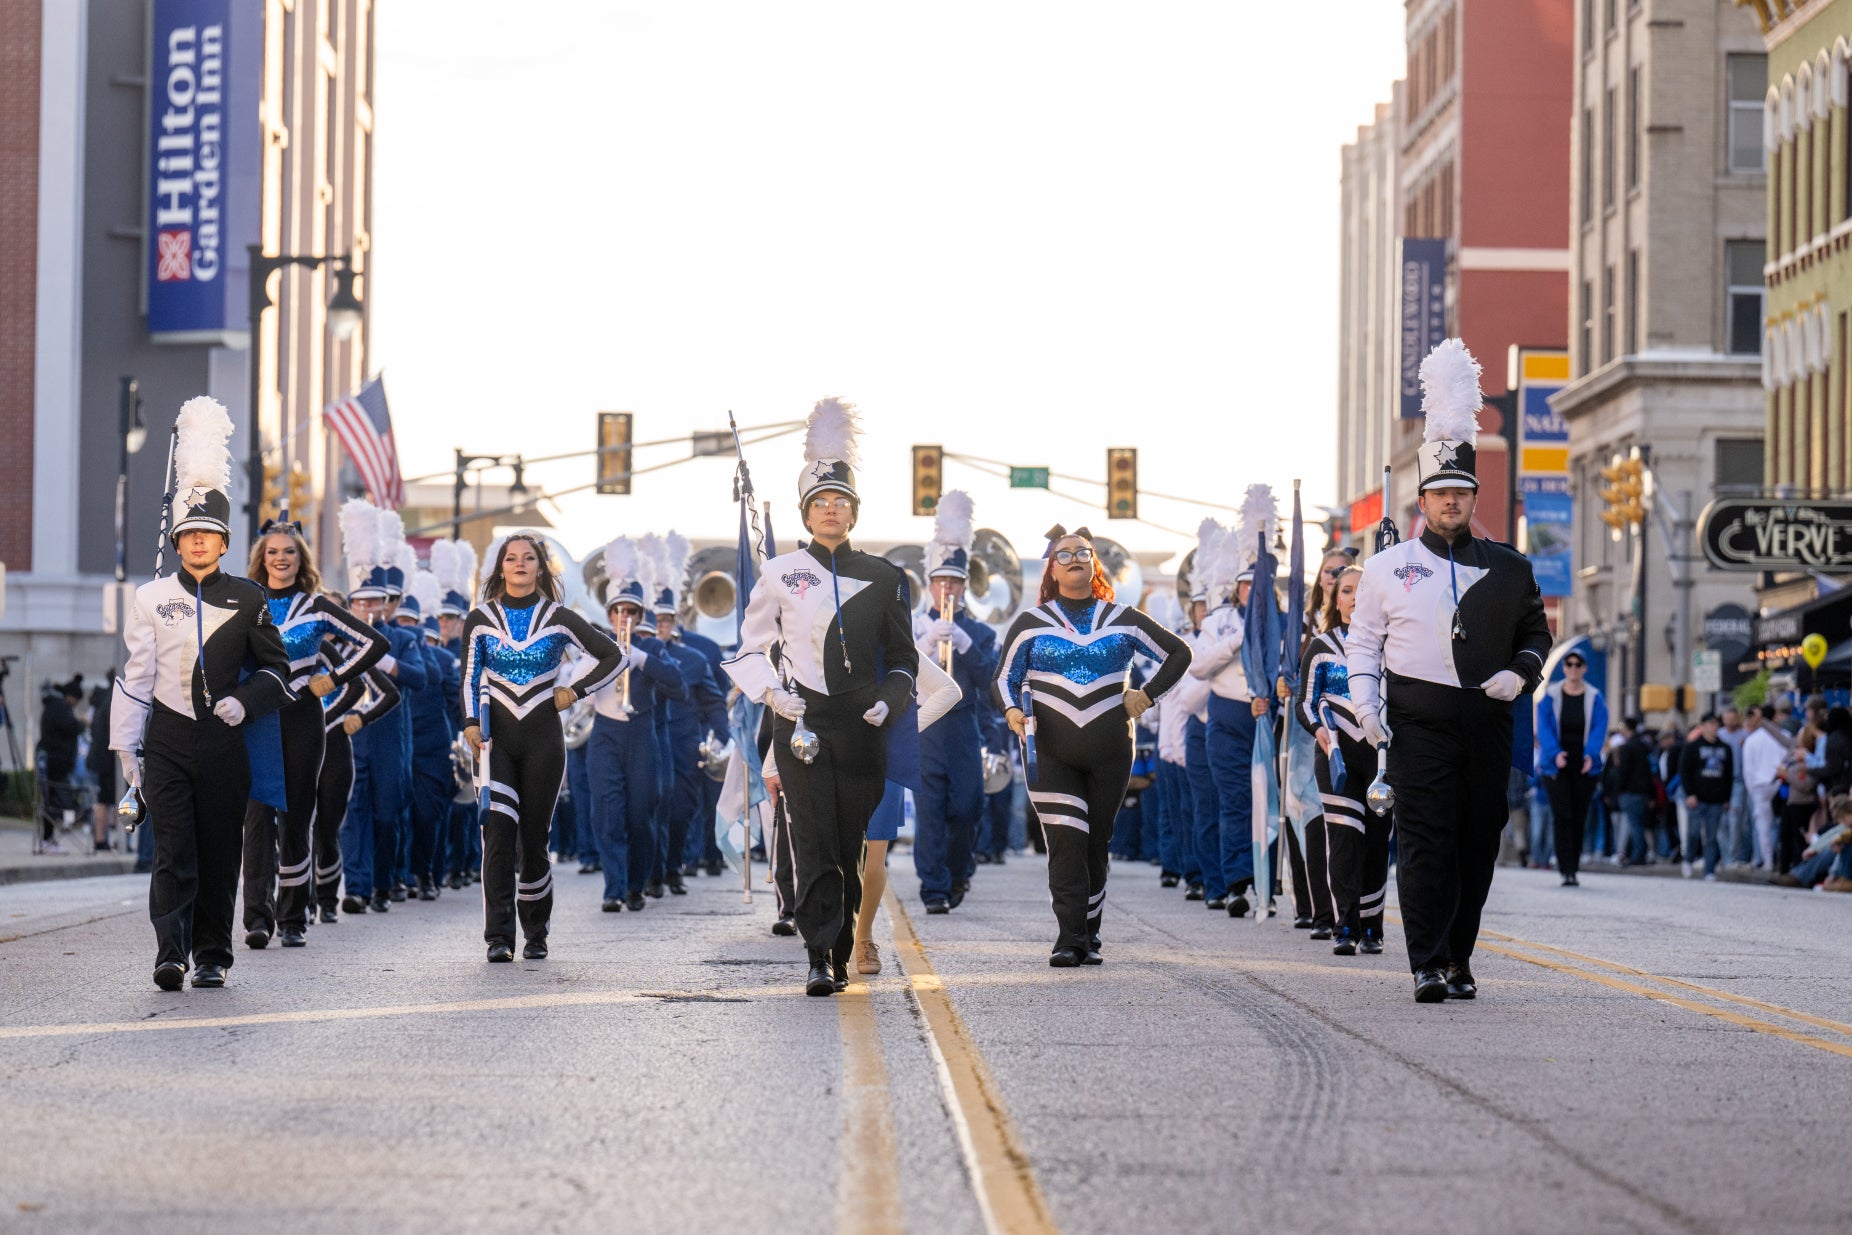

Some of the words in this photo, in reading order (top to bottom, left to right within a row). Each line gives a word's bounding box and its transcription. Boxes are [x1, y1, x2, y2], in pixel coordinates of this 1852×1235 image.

[156, 24, 196, 227] Hilton
[195, 24, 222, 105] Inn
[191, 111, 221, 282] Garden
[1755, 522, 1841, 562] VERVE
